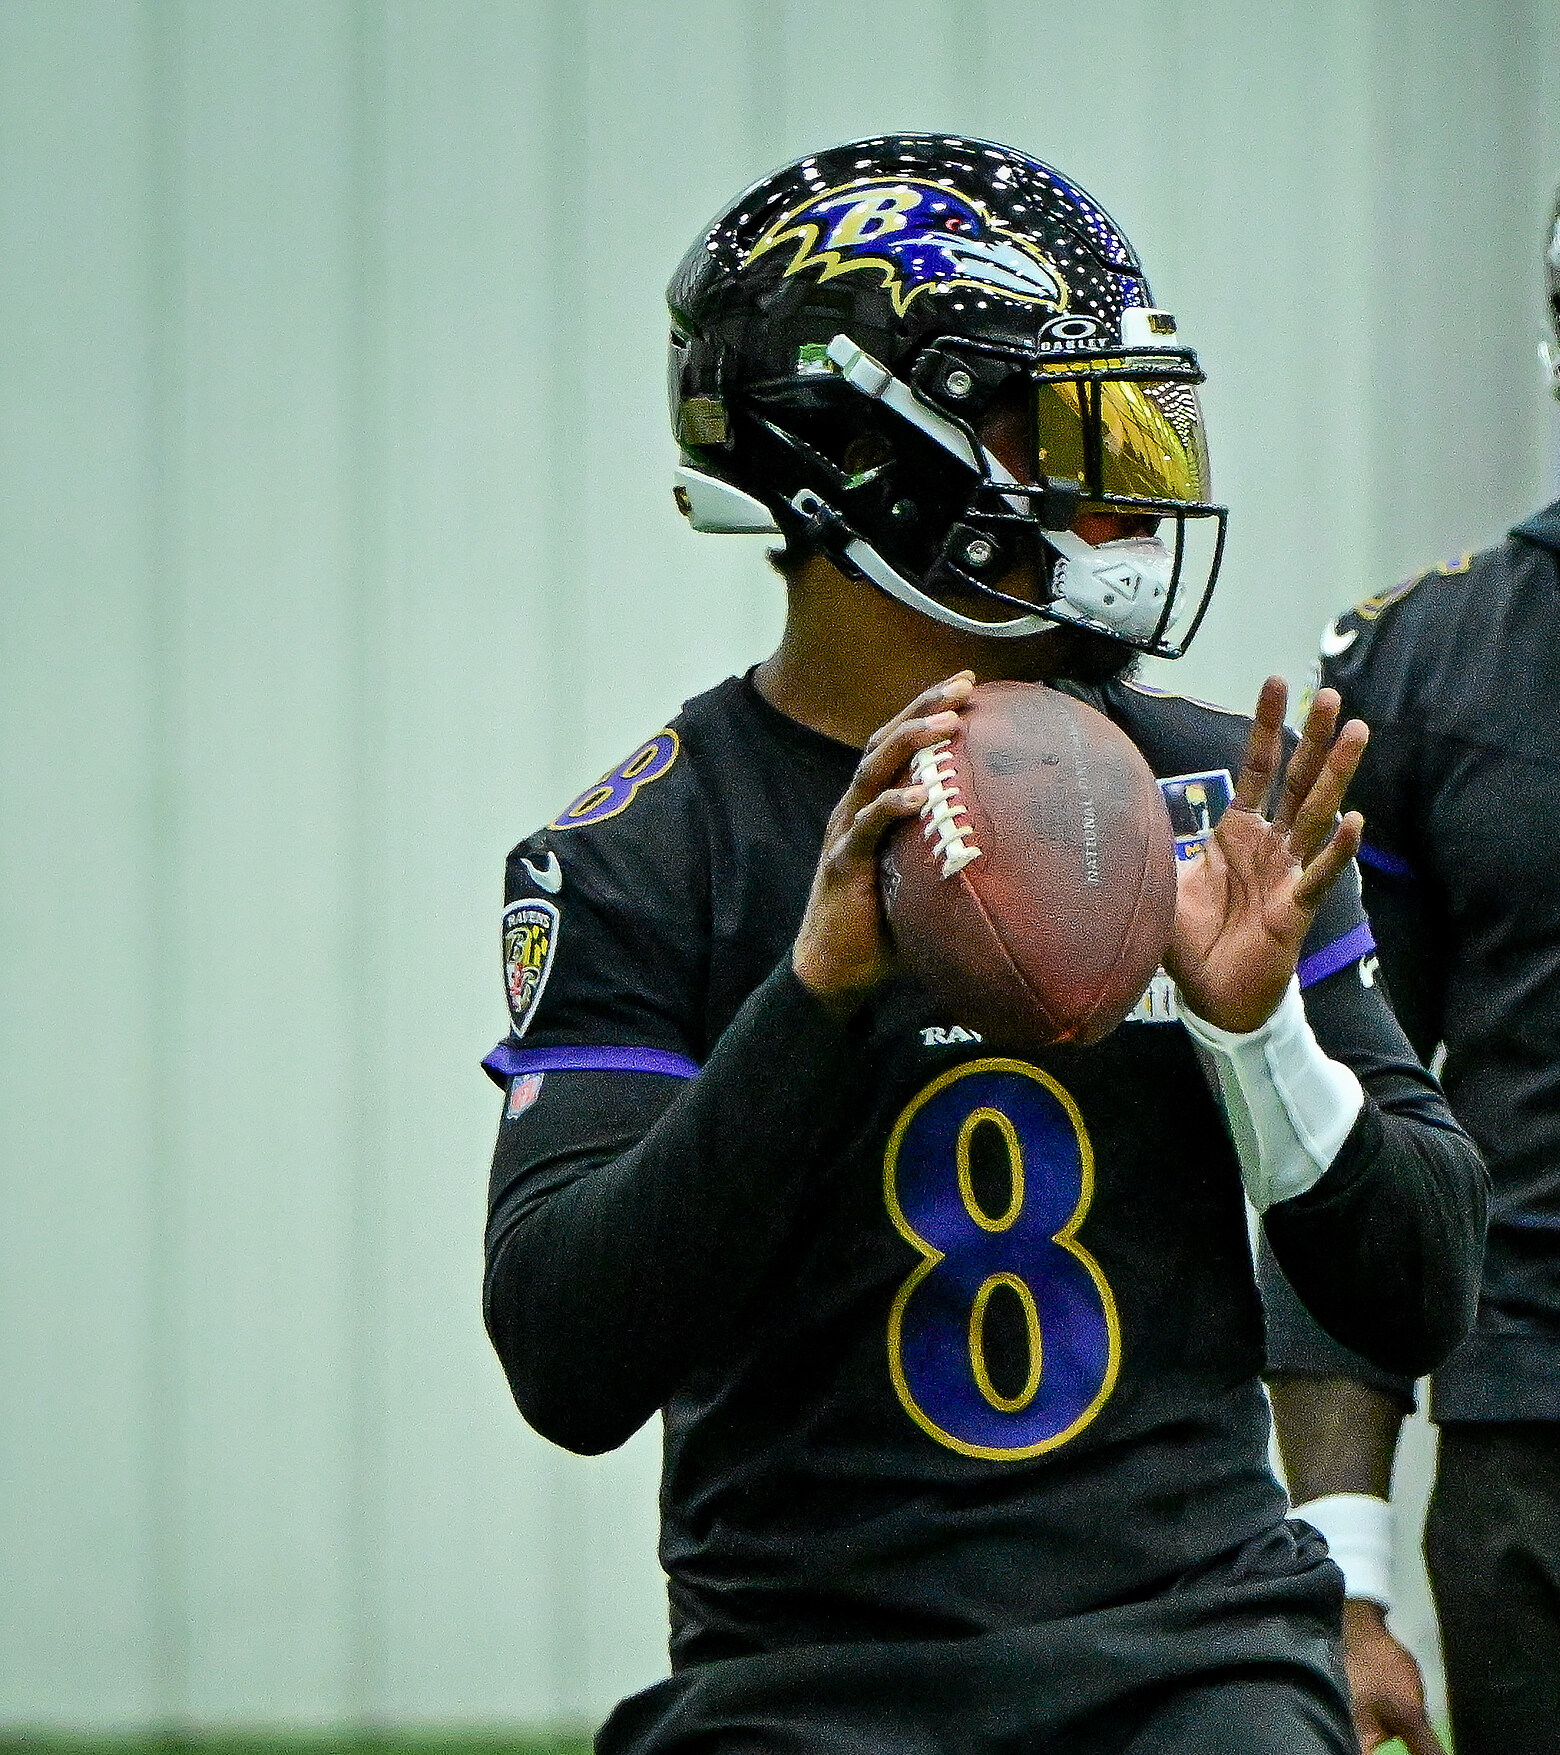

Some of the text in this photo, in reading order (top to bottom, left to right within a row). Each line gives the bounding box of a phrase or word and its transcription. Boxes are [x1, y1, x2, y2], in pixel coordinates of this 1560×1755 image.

[548, 728, 680, 831] 8
[507, 910, 551, 929] RAVENS
[882, 1056, 1122, 1461] 8
